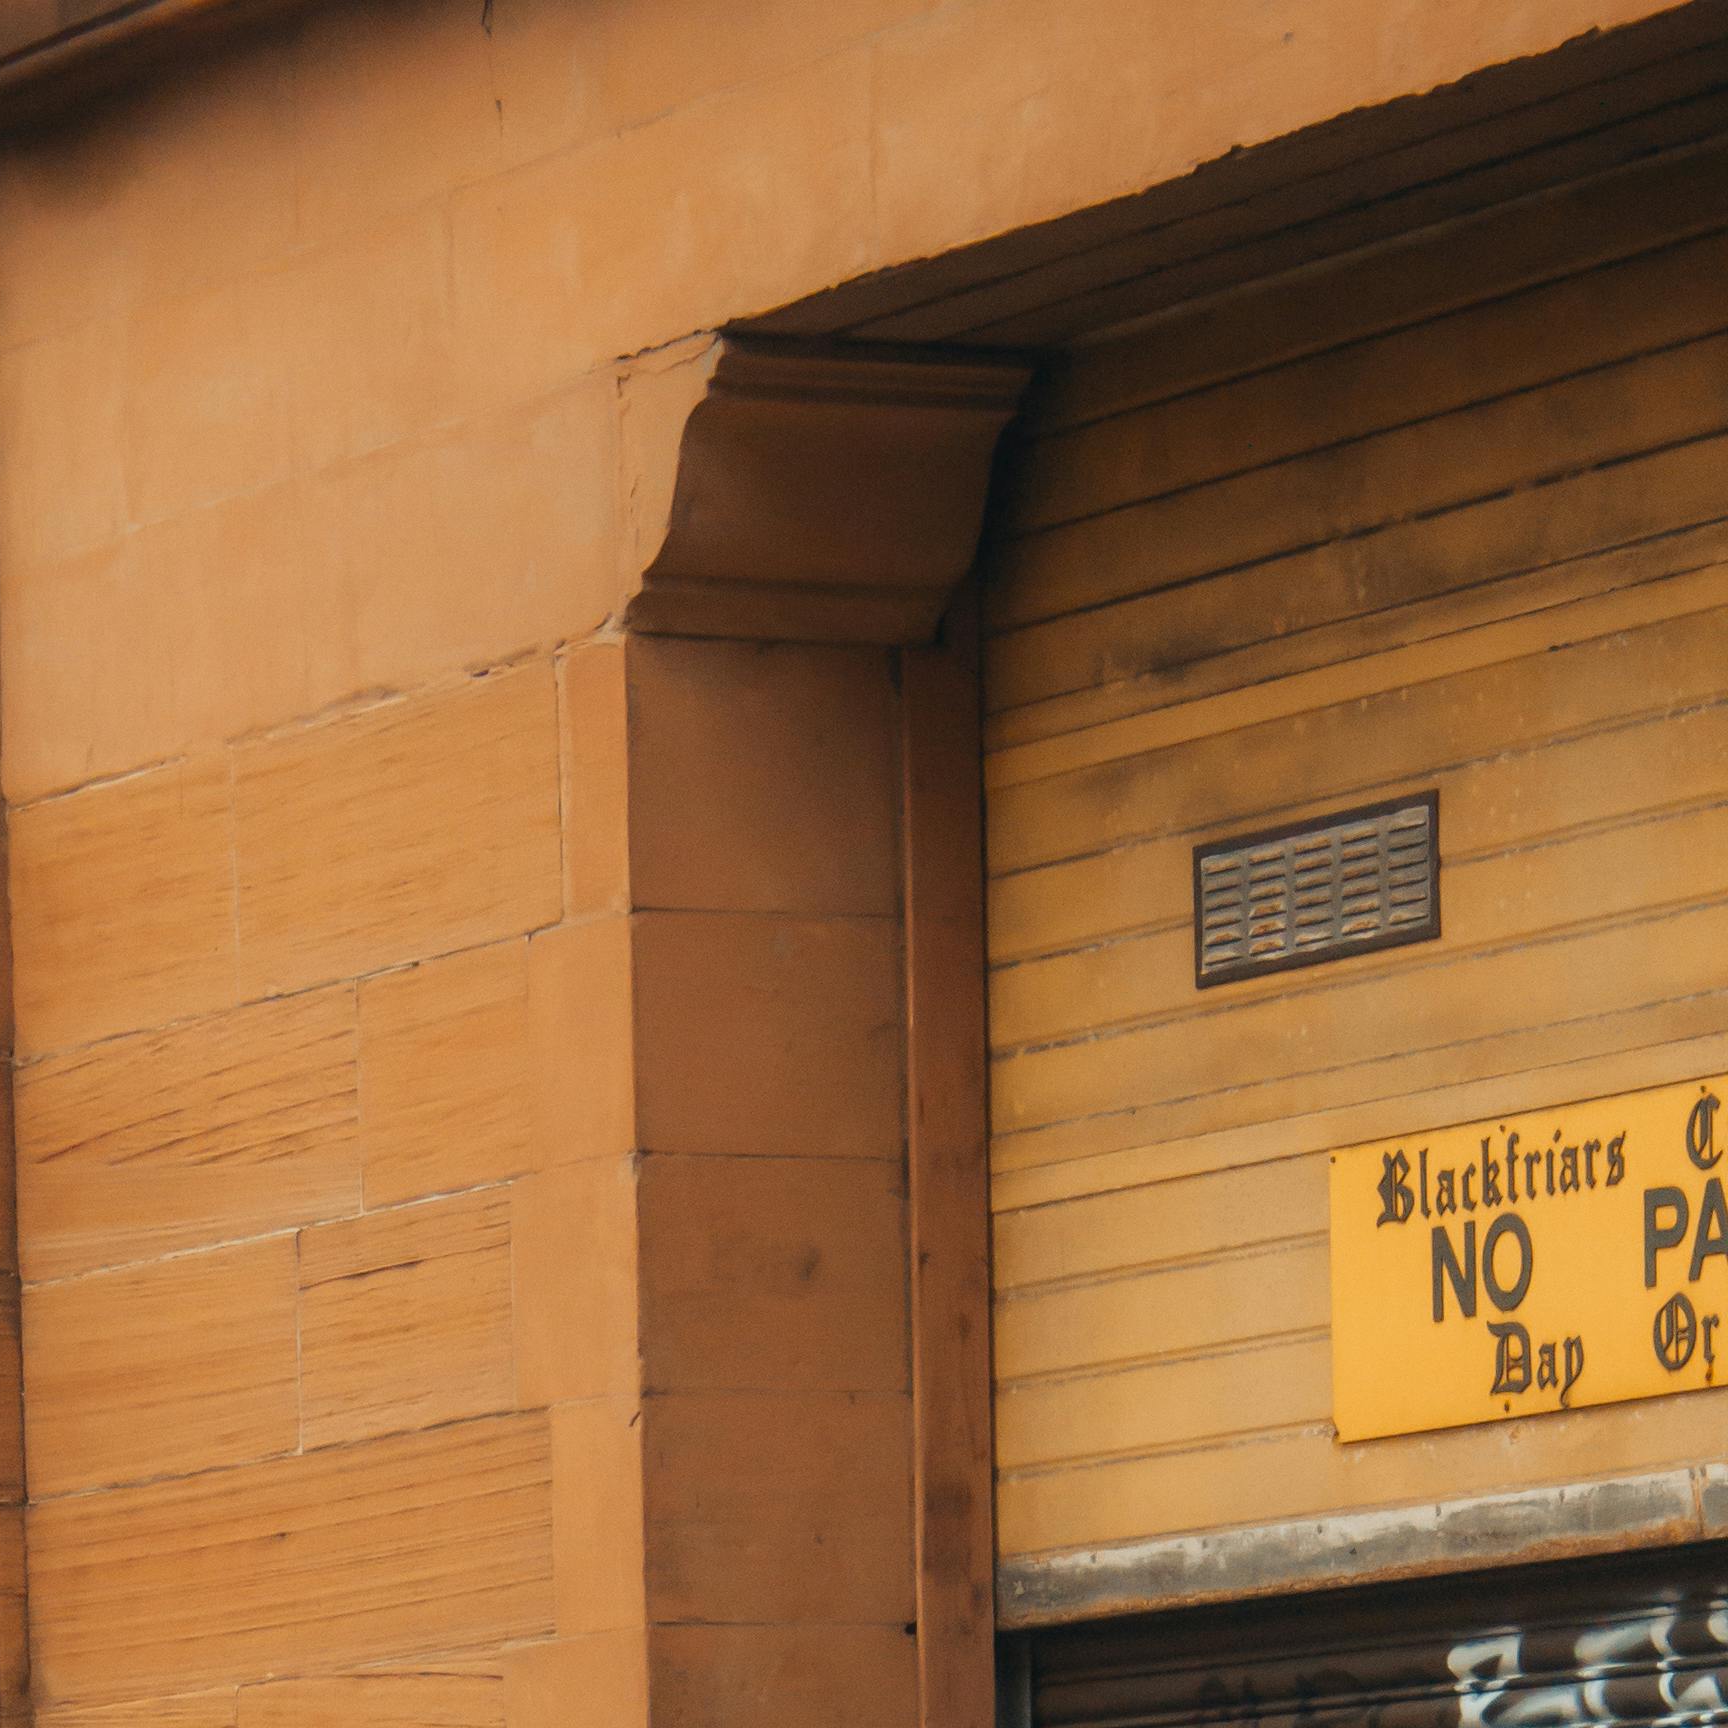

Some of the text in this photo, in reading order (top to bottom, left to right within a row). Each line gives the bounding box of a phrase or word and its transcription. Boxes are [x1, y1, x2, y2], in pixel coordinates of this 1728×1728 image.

[1376, 1131, 1626, 1228] Blackfriars
[1431, 1212, 1533, 1322] NO
[1486, 1291, 1719, 1409] Day Or
